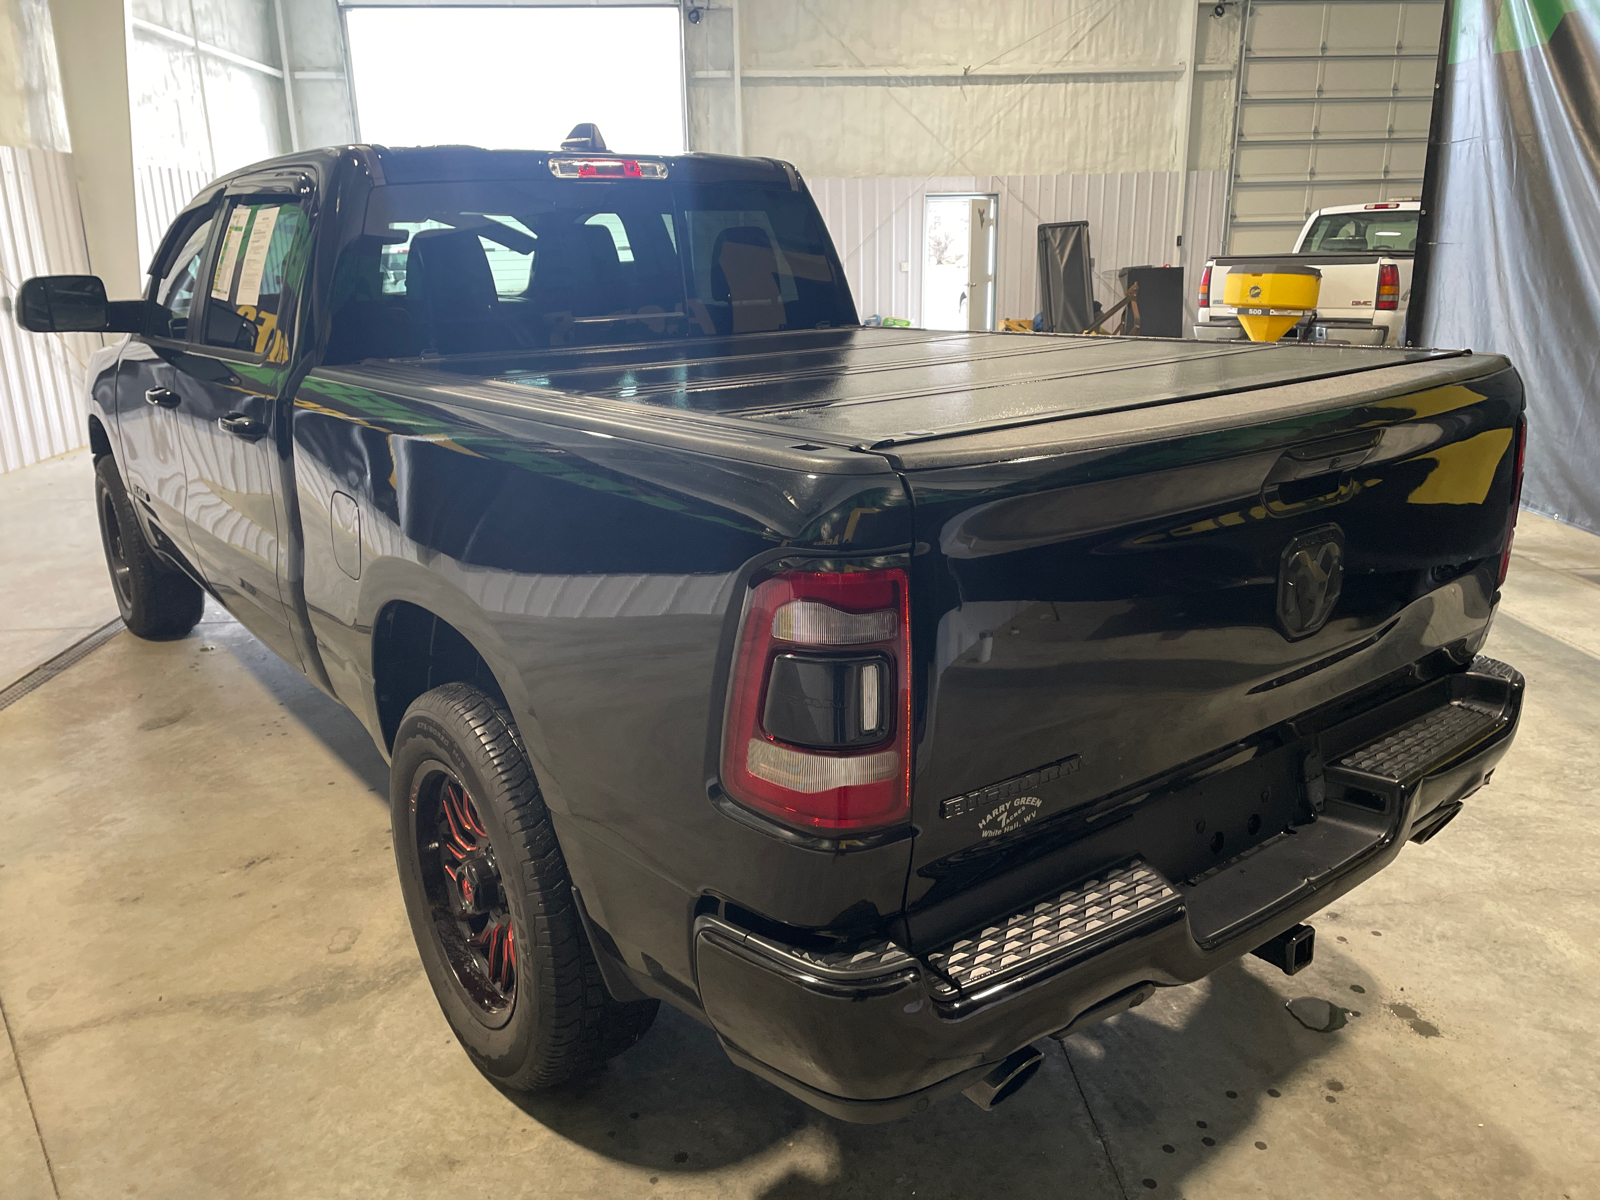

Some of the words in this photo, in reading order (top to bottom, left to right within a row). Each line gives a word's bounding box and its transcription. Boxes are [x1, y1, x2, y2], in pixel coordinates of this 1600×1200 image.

[978, 801, 1011, 829] HARRY
[1014, 796, 1043, 808] GREEN
[981, 828, 1002, 838] White
[1023, 810, 1037, 823] WV
[997, 811, 1008, 828] 7
[1006, 806, 1026, 824] ACRES
